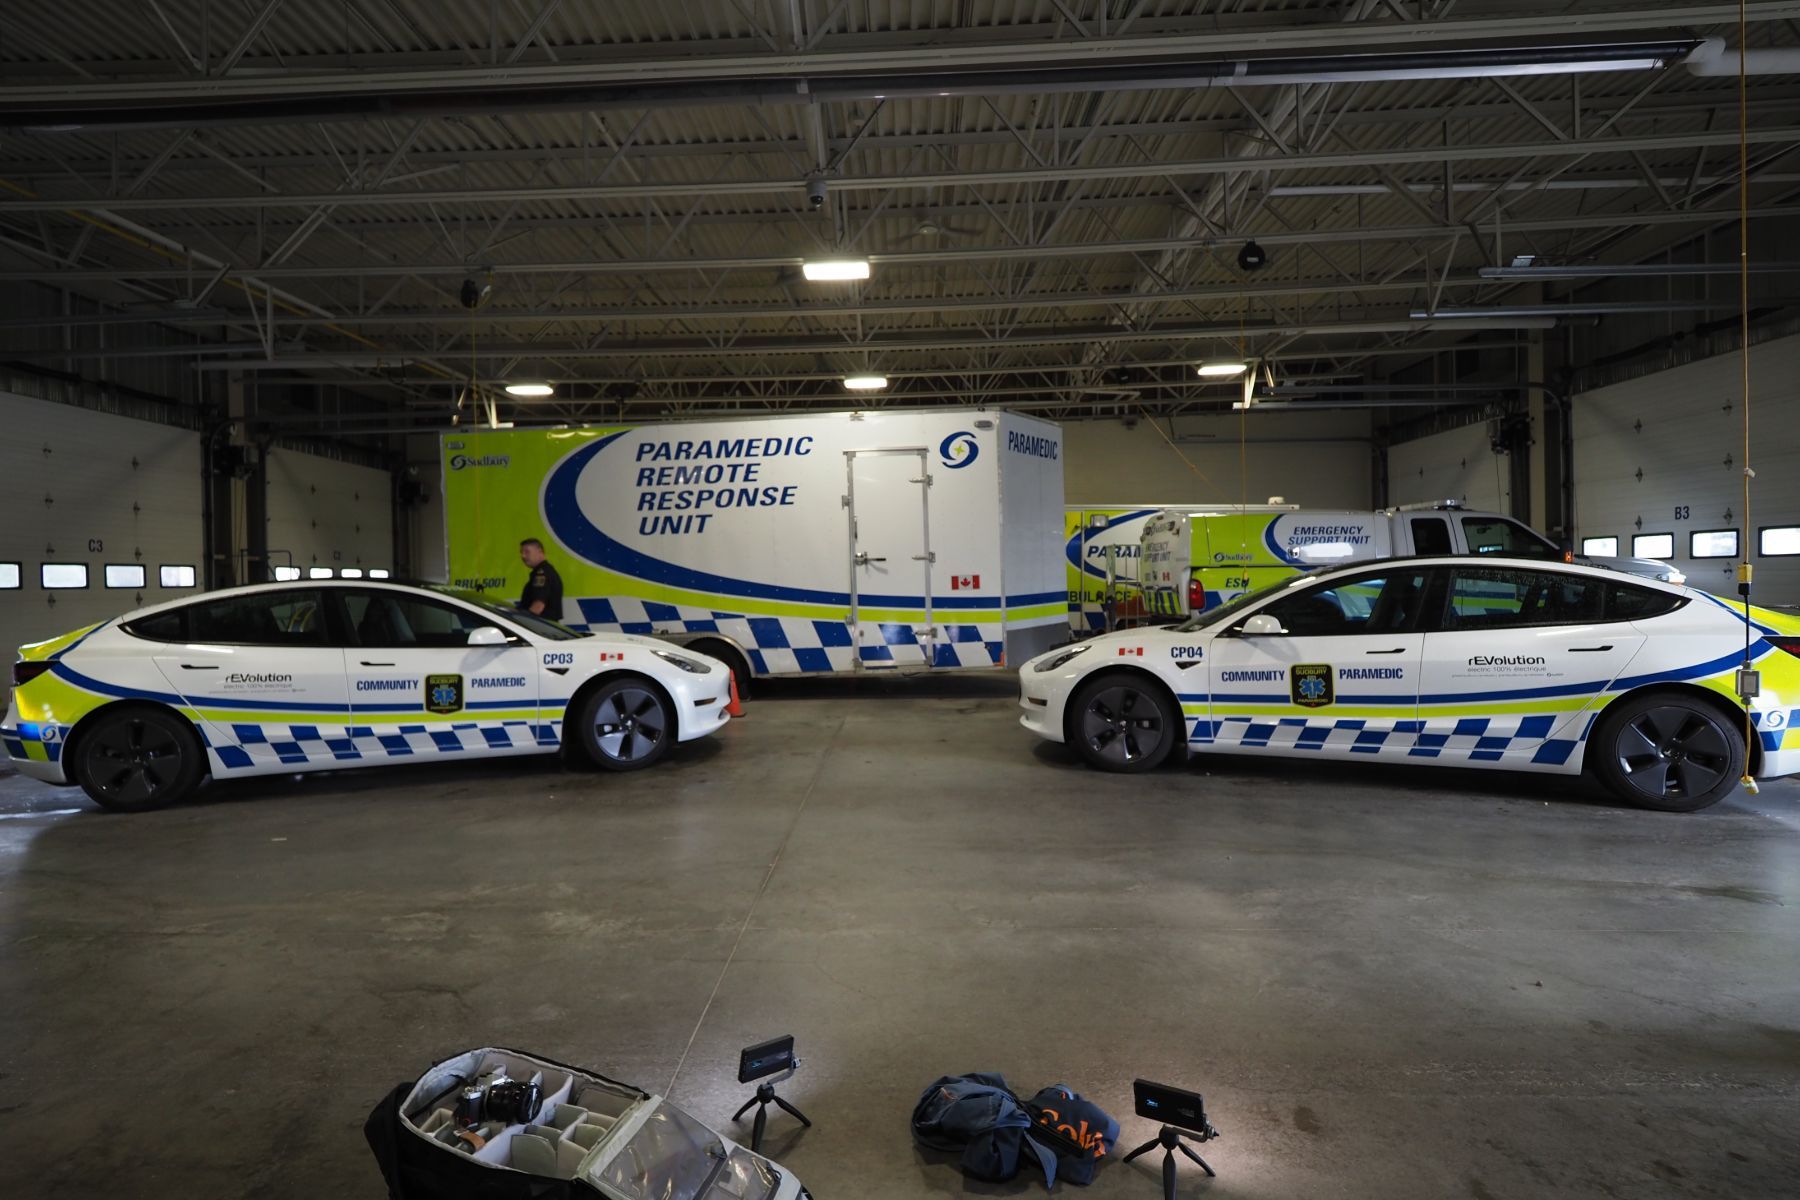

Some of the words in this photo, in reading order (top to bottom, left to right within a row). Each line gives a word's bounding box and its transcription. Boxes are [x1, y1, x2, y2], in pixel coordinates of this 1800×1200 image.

[635, 436, 814, 462] PARAMEDIC
[1008, 430, 1058, 461] PARAMEDIC
[635, 463, 761, 487] REMOTE
[637, 486, 798, 511] RESPONSE
[1674, 505, 1690, 520] B3
[638, 514, 713, 536] UNIT
[1293, 526, 1364, 536] EMERGENCY
[88, 538, 103, 553] C3
[1288, 536, 1339, 546] SUPPORT
[1342, 535, 1371, 545] UNIT
[1225, 577, 1250, 588] ESU
[543, 653, 574, 665] CP03
[1171, 646, 1203, 659] CP04
[1468, 655, 1545, 666] rEVolution
[225, 673, 292, 683] rEVolution
[1221, 669, 1285, 683] COMMUNITY
[1339, 667, 1403, 681] PARAMEDIC
[356, 679, 419, 692] COMMUNITY
[471, 676, 526, 689] PARAMEDIC
